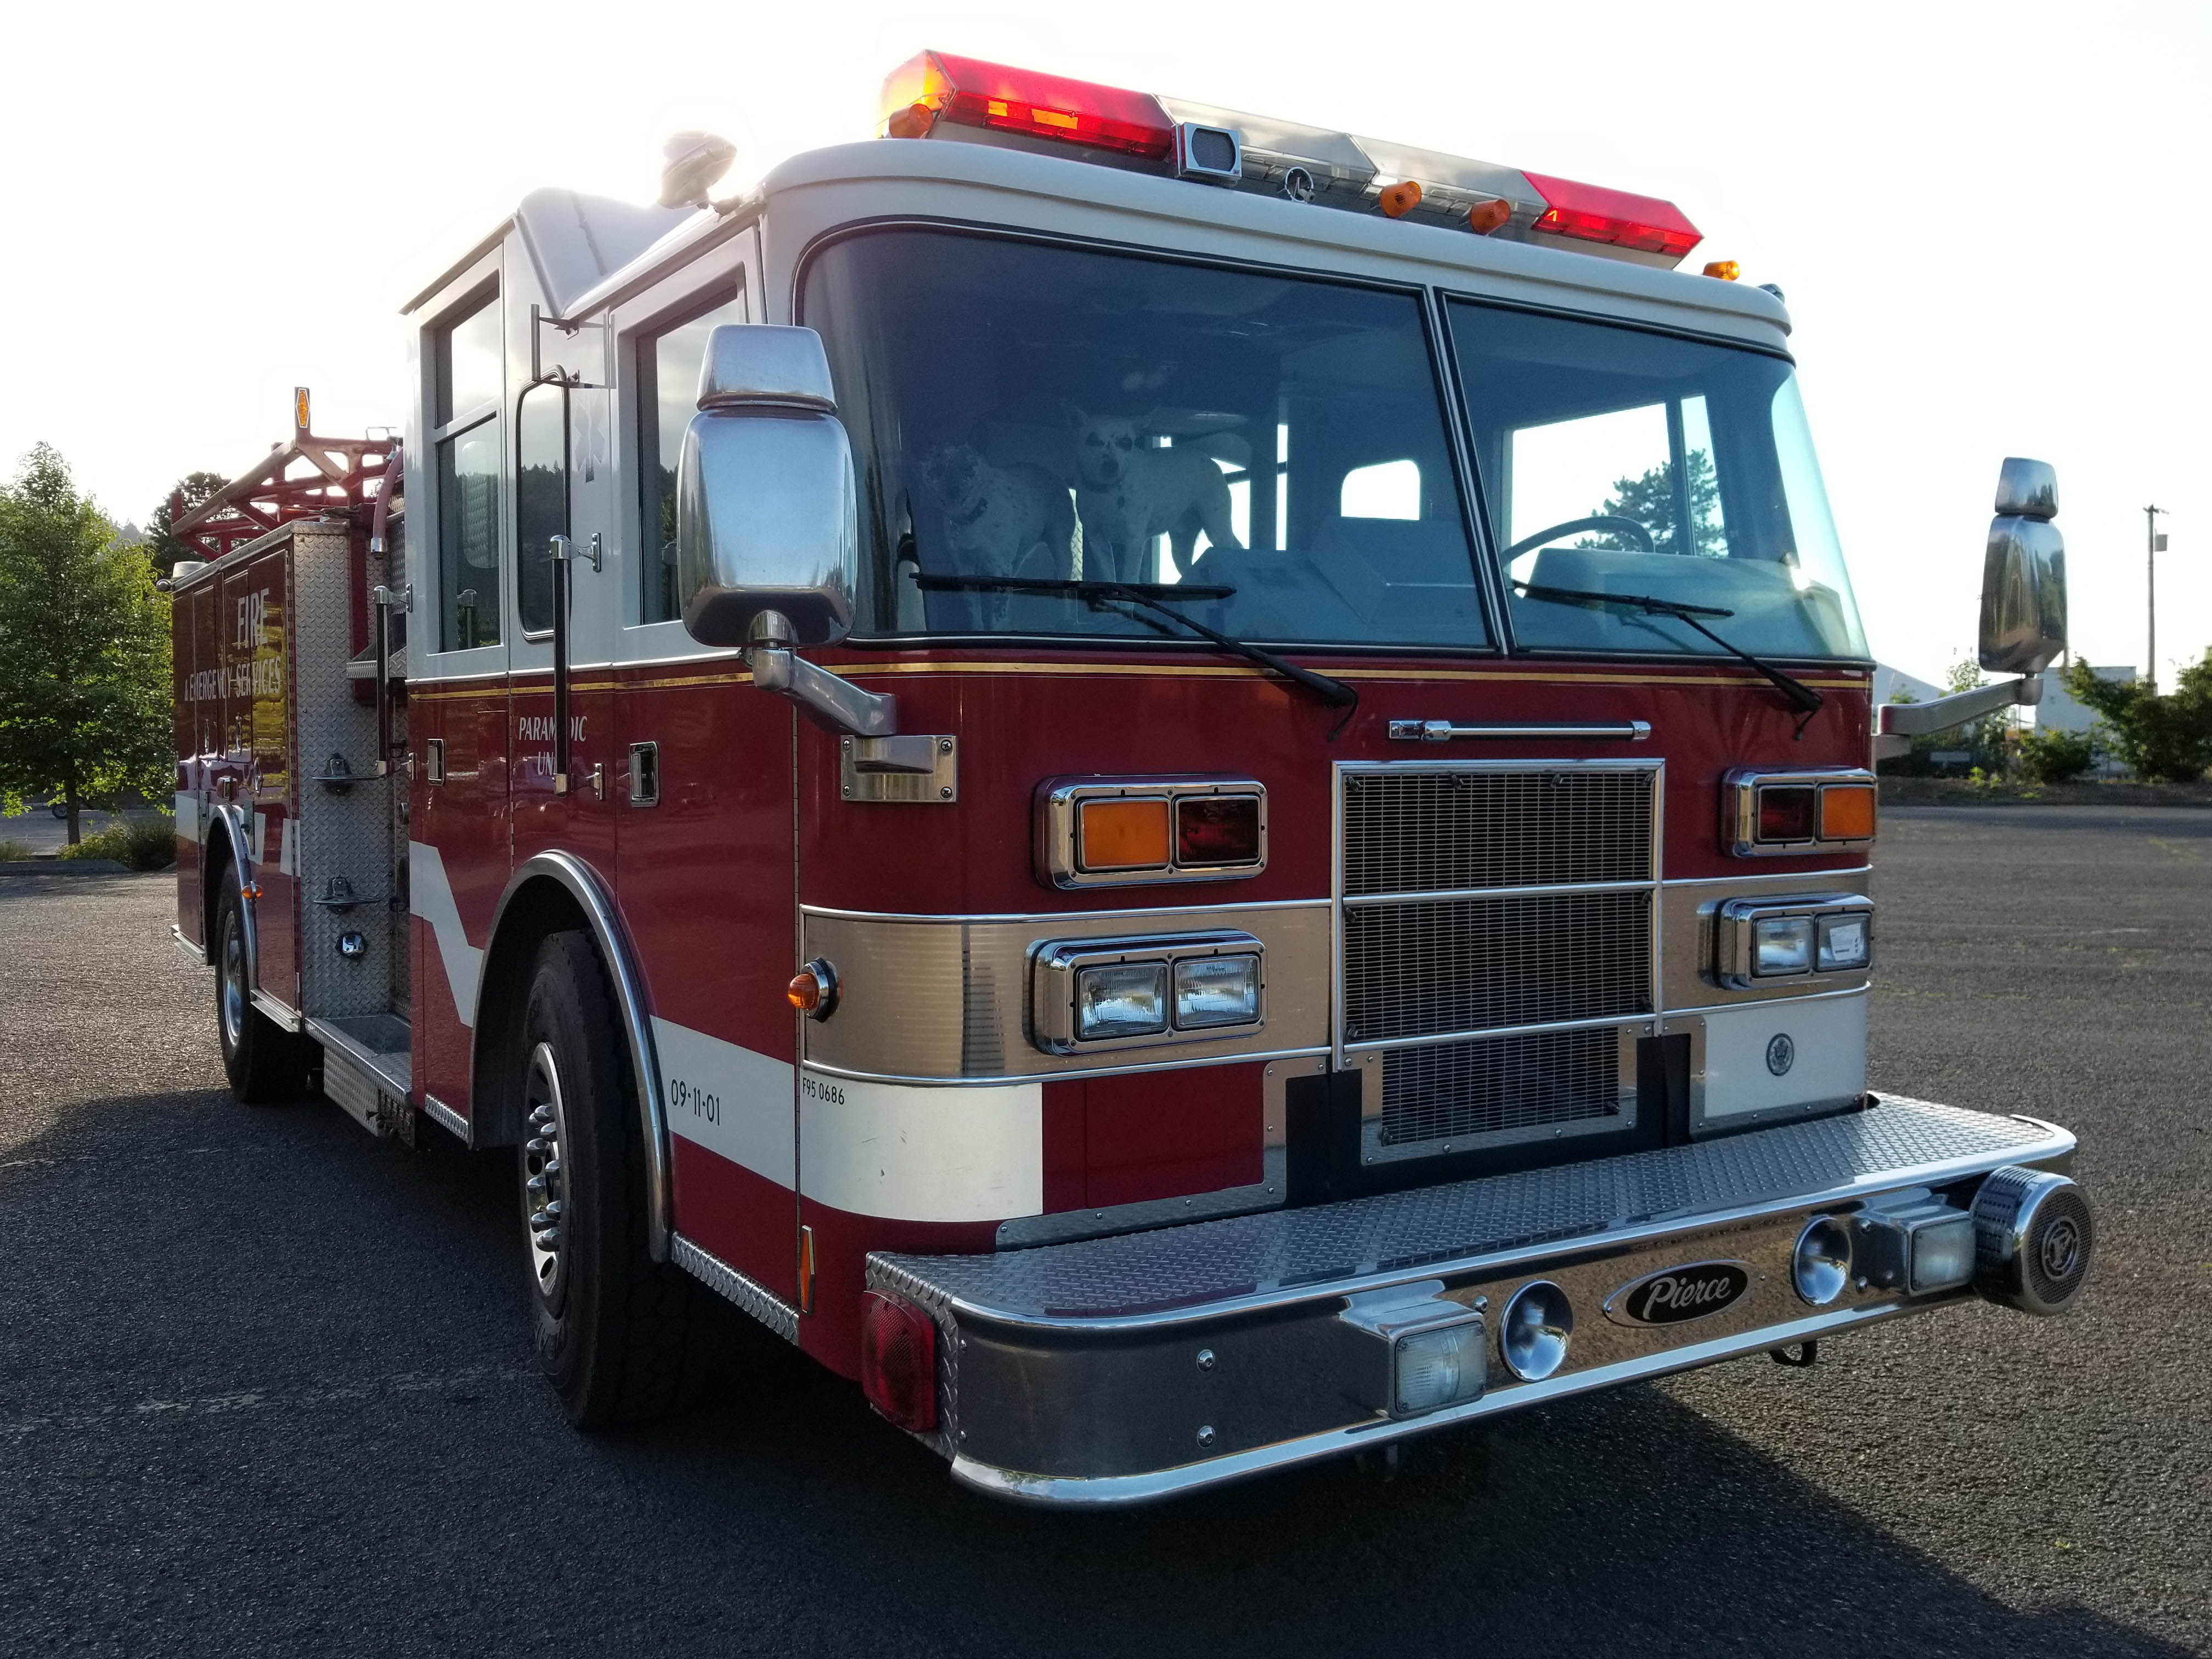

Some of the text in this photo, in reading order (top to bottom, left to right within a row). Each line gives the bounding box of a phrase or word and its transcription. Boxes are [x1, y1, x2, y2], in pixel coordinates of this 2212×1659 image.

[237, 588, 269, 650] FIRE
[184, 656, 281, 702] & EMERGENCY SERVICES
[518, 715, 588, 742] PARAMIC
[538, 751, 557, 776] UN
[671, 1079, 720, 1126] 09-11-01
[802, 1077, 845, 1105] F95 0686
[1643, 1277, 1731, 1319] Pierce
